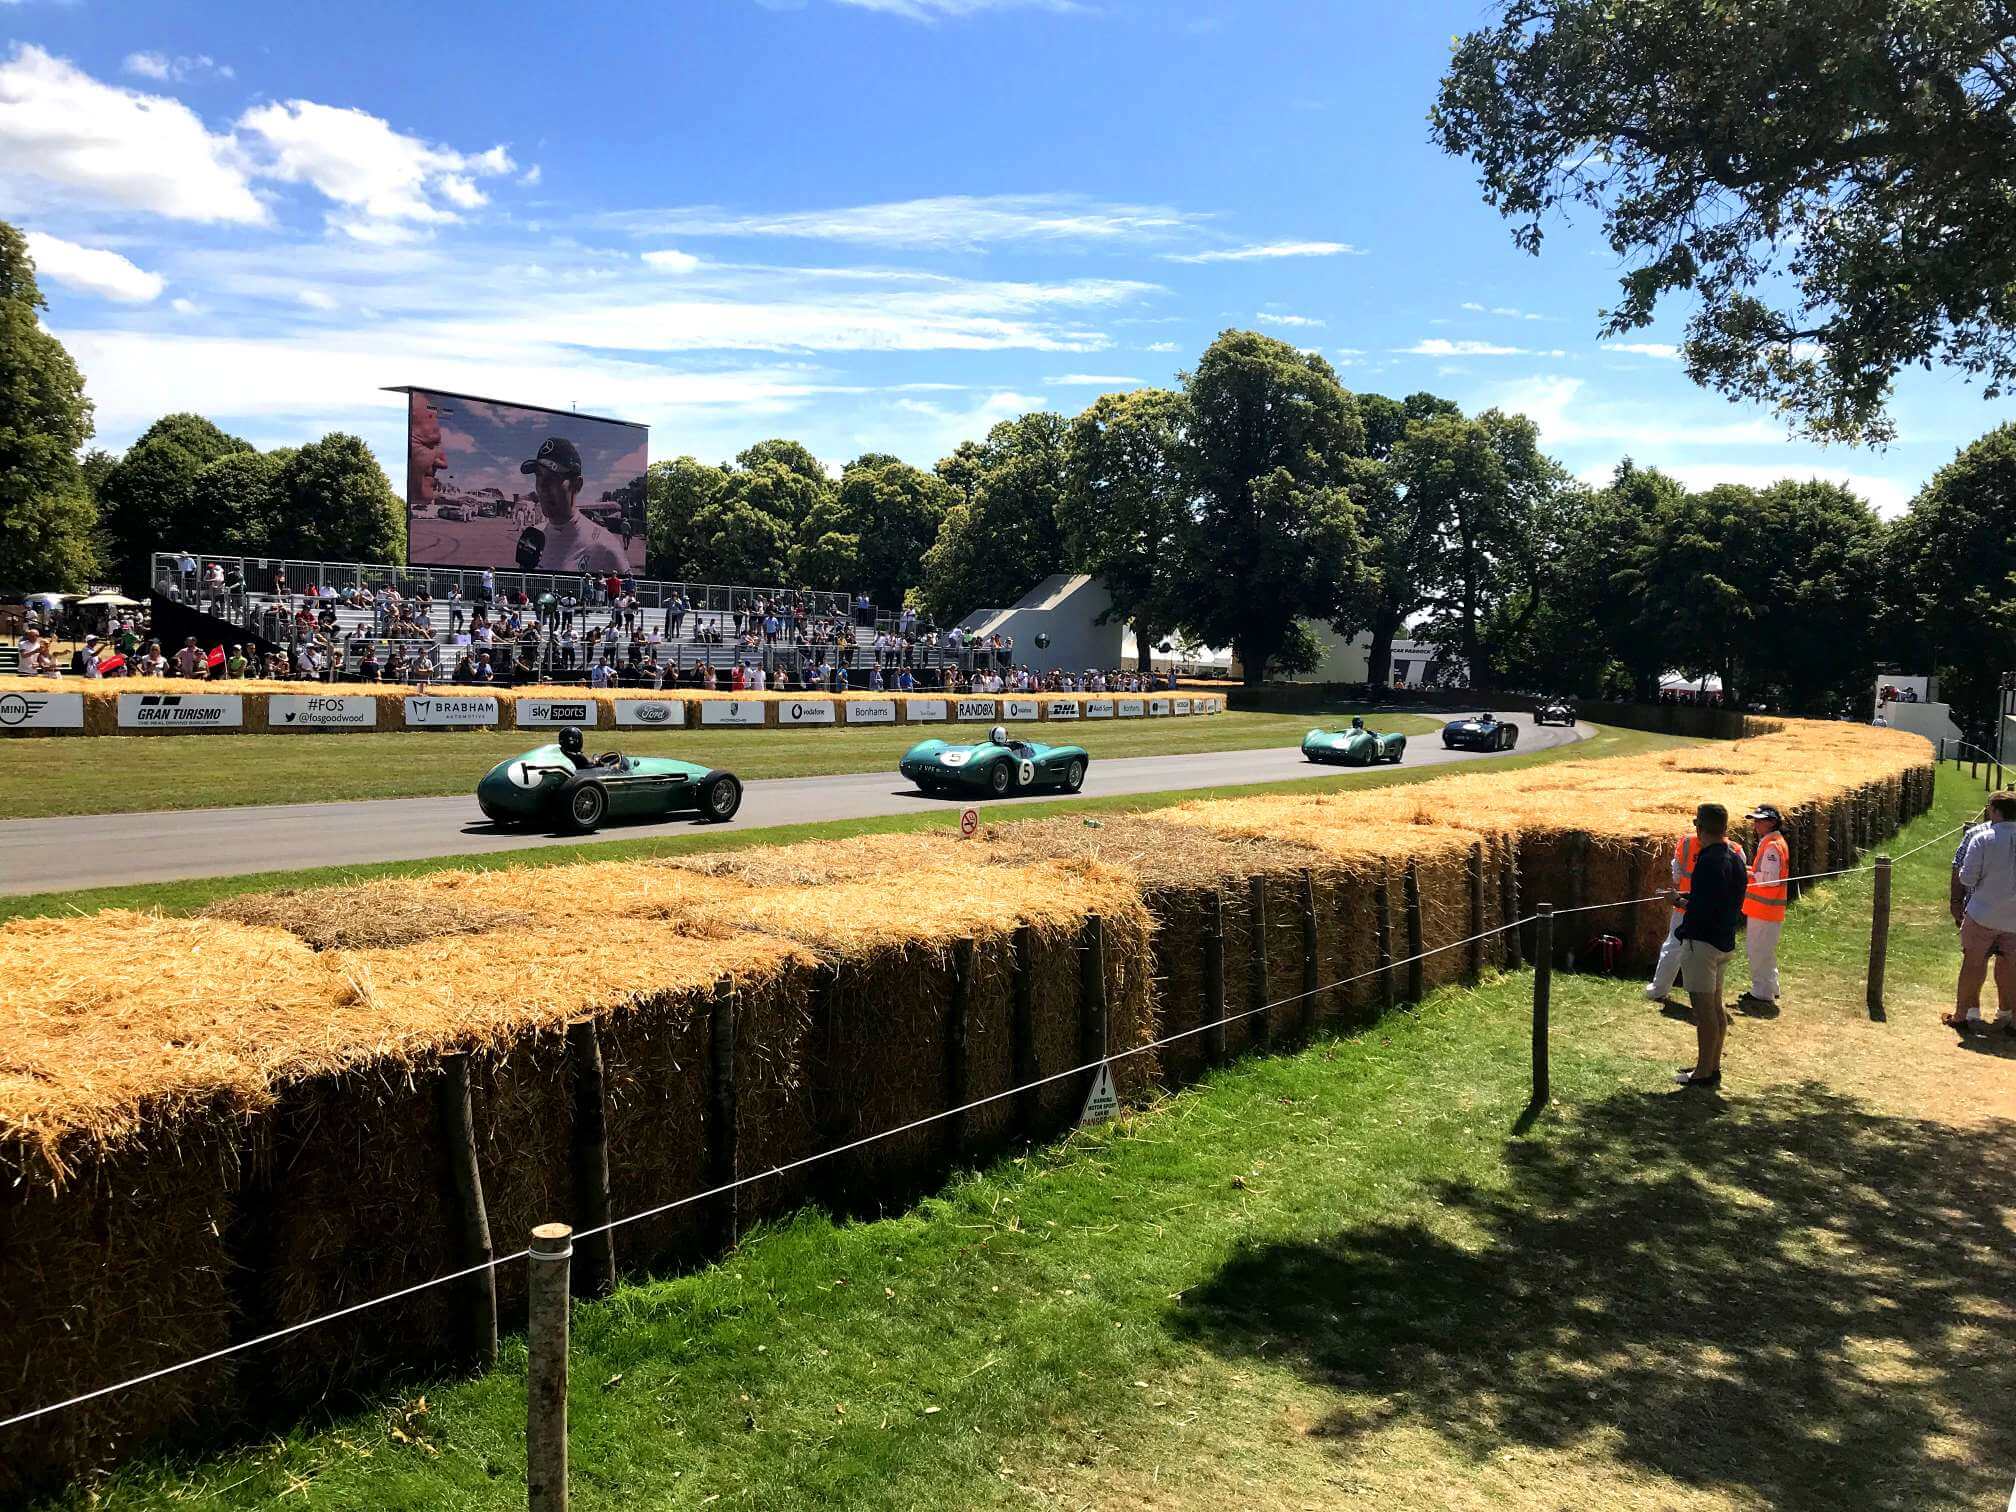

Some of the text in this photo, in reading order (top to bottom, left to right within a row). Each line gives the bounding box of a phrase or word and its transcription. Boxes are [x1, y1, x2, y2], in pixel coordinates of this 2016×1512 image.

[1, 705, 25, 714] MINI
[308, 698, 344, 712] #FOS
[436, 703, 494, 712] BRABHAM
[959, 703, 994, 716] RANDOX
[138, 708, 221, 720] GRAN TURISMO
[532, 705, 585, 719] sky sports
[641, 704, 665, 719] Ford
[803, 708, 825, 716] vodafone
[855, 707, 888, 717] Bonhams
[299, 713, 364, 724] @fosgoodwood
[950, 753, 961, 762] 5
[1023, 763, 1031, 780] 5
